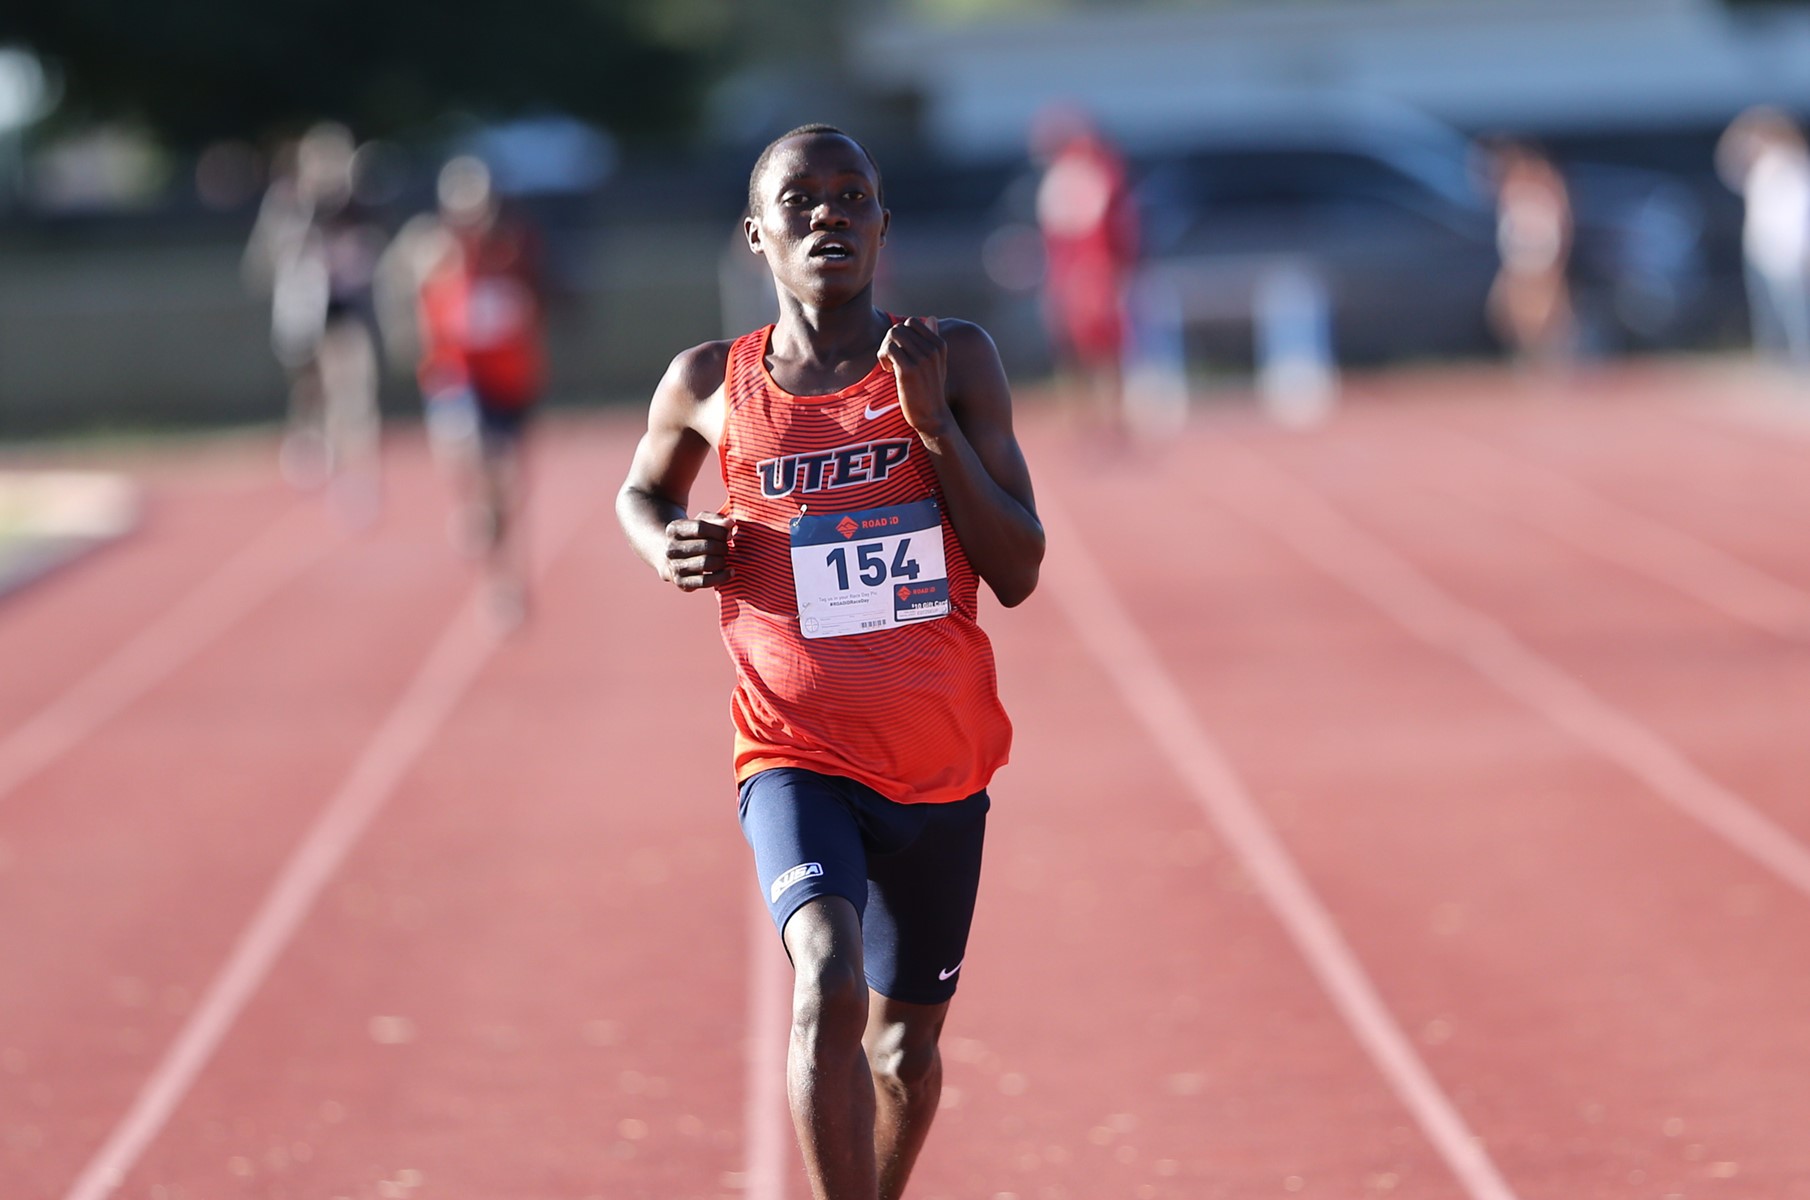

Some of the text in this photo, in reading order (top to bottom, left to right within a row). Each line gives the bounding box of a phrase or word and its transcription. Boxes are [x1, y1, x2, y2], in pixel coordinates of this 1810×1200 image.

[757, 438, 912, 498] UTEP
[862, 518, 888, 529] ROAD
[826, 538, 920, 590] 154
